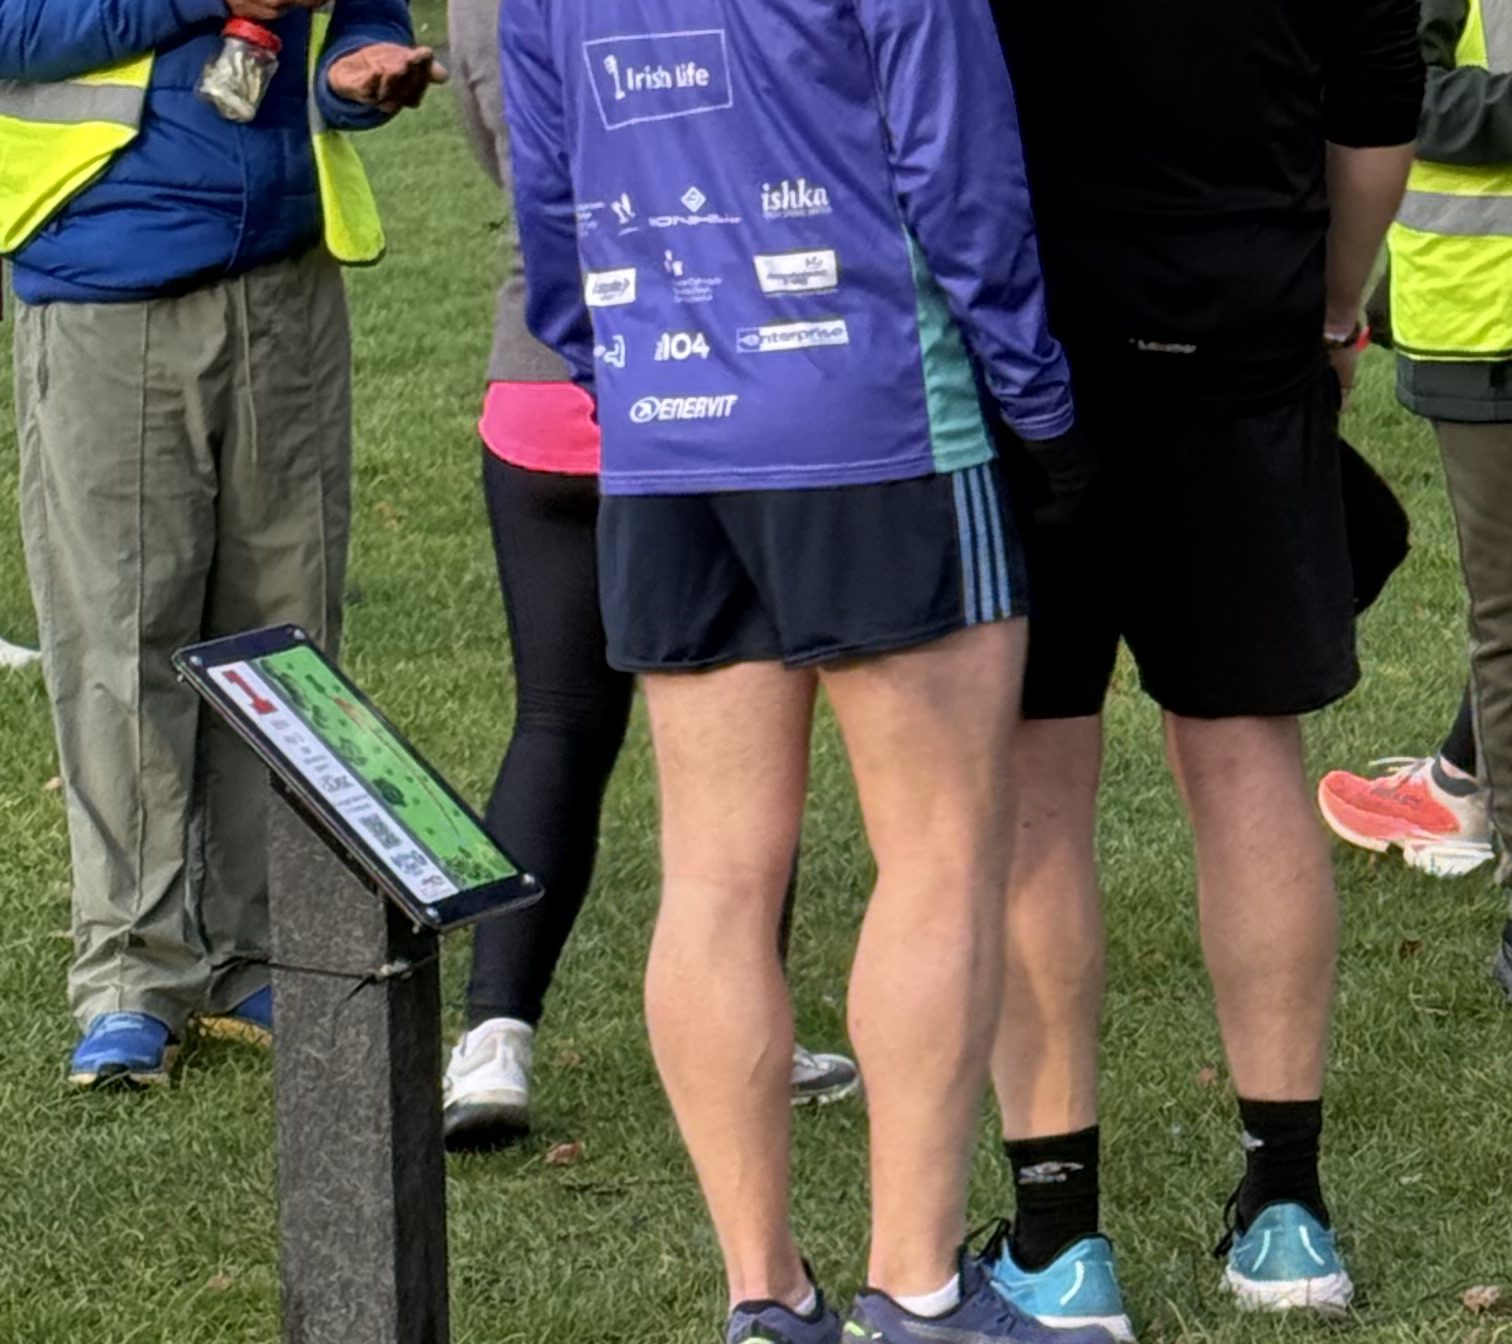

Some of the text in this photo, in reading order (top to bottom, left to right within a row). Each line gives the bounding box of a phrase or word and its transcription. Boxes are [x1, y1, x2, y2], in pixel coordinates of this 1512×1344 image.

[626, 61, 710, 91] Irish Life
[761, 178, 829, 212] ishka
